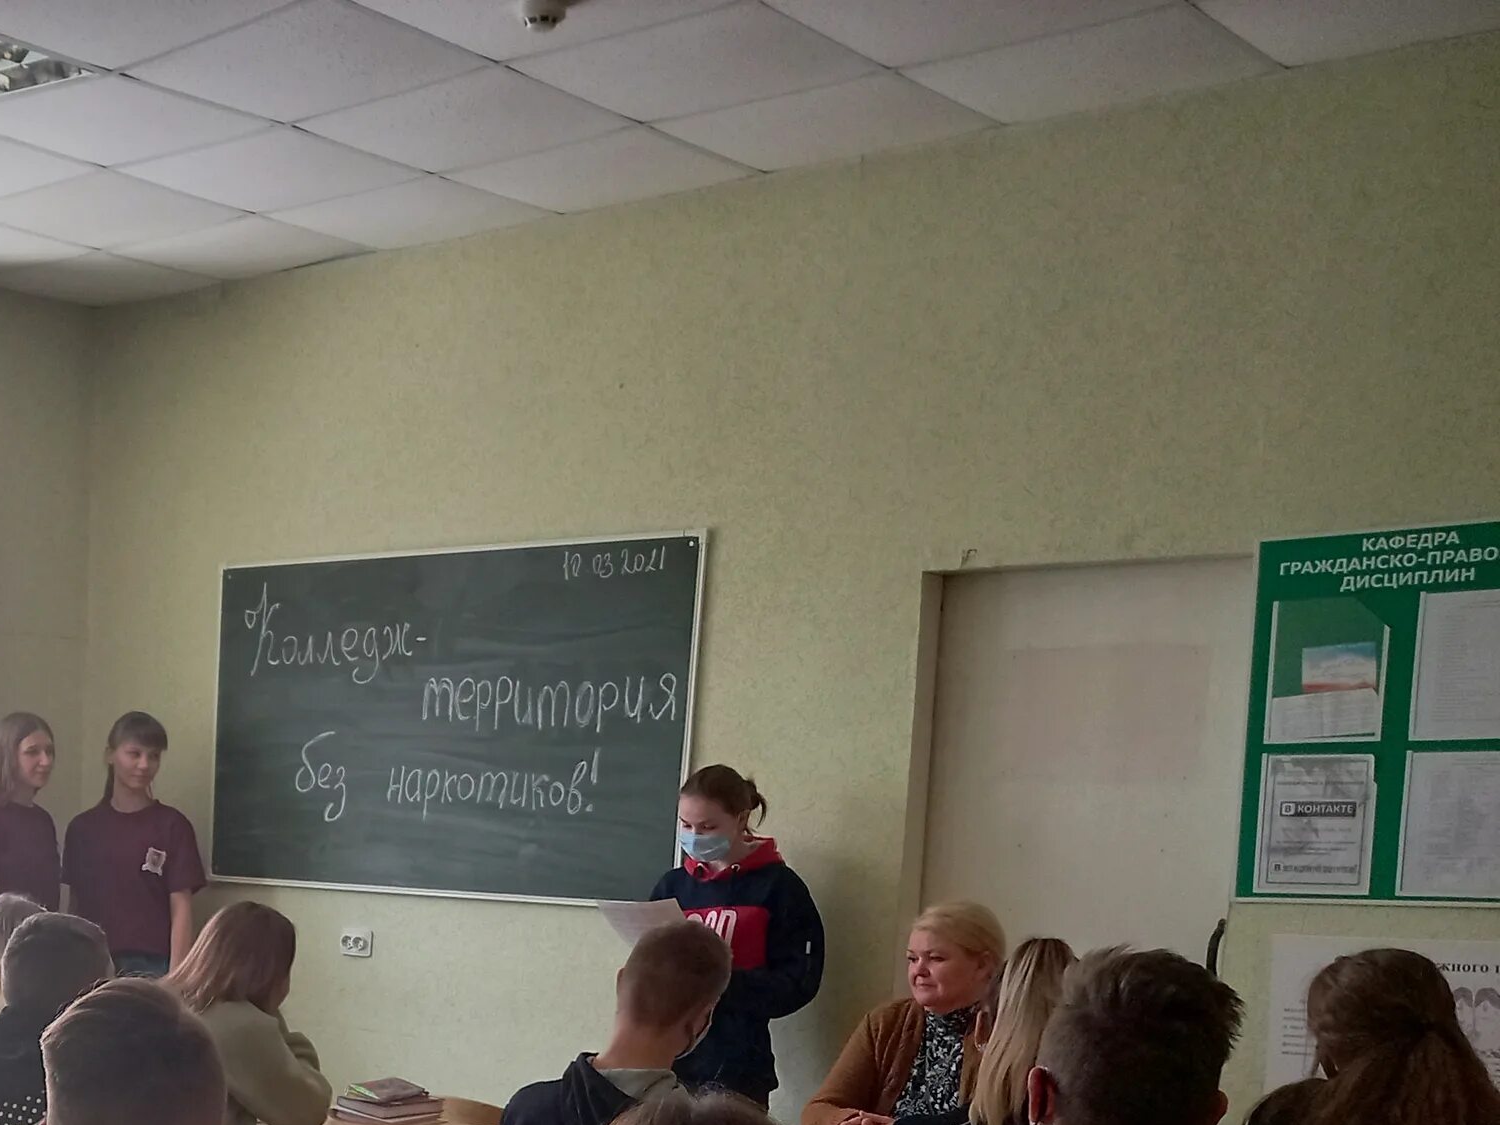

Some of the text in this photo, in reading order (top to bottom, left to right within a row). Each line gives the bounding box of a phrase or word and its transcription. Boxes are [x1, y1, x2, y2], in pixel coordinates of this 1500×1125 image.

[1362, 530, 1461, 552] КАФЕДРА
[1339, 567, 1476, 593] ДИСЦИПЛИН
[422, 673, 678, 733] территория
[294, 731, 600, 822] без наркотиков!
[1297, 804, 1353, 814] КОНТАКТЕ
